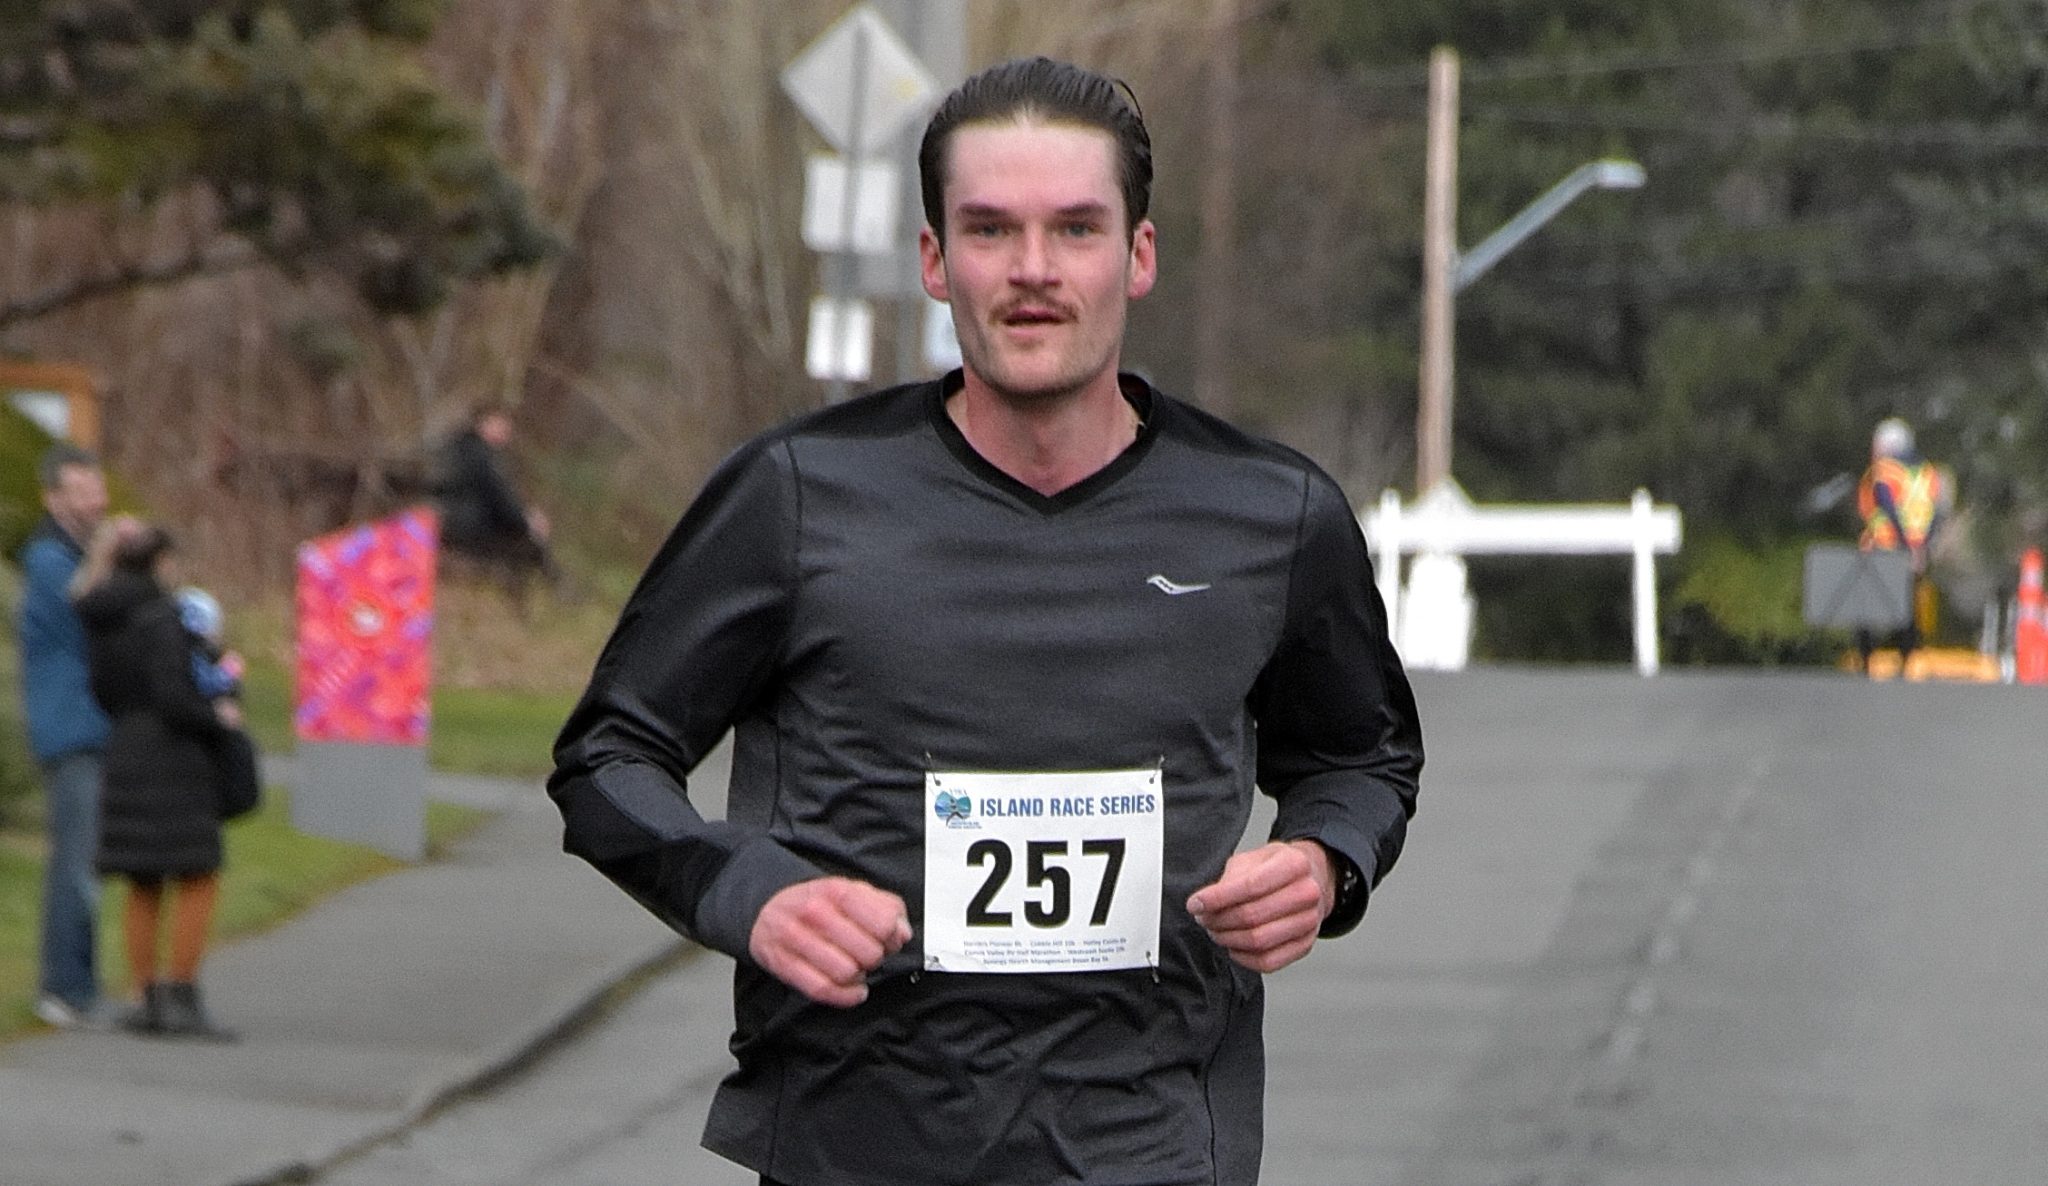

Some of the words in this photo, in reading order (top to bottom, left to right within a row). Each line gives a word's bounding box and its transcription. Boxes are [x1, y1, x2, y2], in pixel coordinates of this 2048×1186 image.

[980, 796, 1043, 817] ISLAND
[1050, 796, 1094, 817] RACE
[1100, 794, 1156, 814] SERIES
[966, 837, 1126, 929] 257
